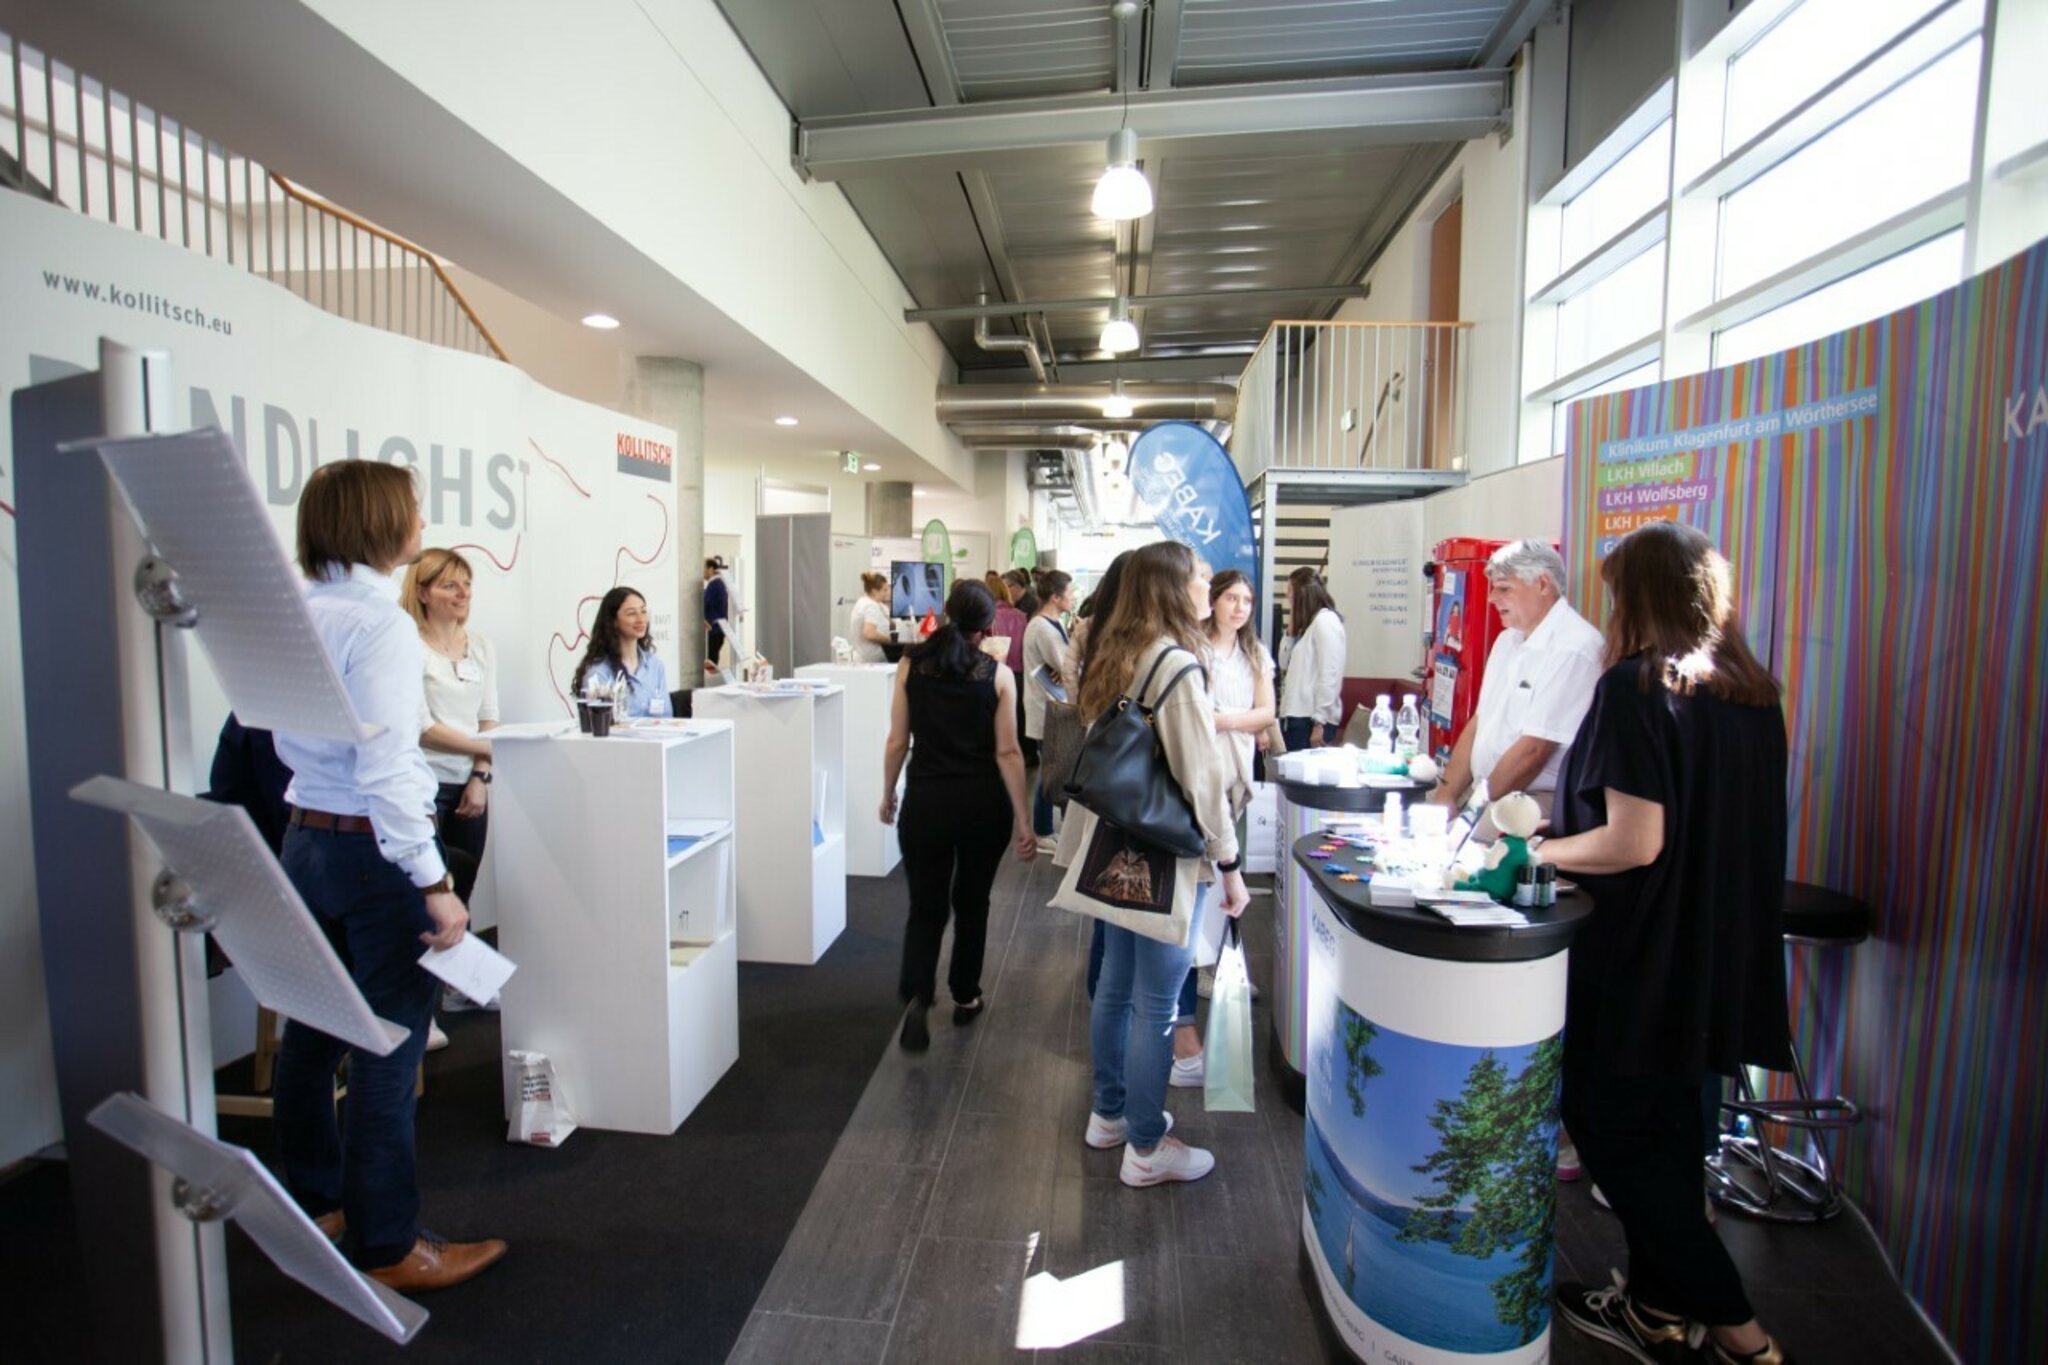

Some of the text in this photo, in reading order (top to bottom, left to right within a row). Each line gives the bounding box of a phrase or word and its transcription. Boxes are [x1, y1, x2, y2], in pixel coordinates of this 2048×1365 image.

[43, 270, 232, 335] www.kollitsch.eu
[1608, 393, 1878, 458] Klinikum Klagenfurt am Wörthersee
[2003, 385, 2048, 442] KA
[617, 432, 672, 466] KOLLITSCH
[1607, 458, 1685, 482] LKH Villach
[1605, 483, 1707, 507] LKH Wolfsberg
[1605, 514, 1632, 530] LKH
